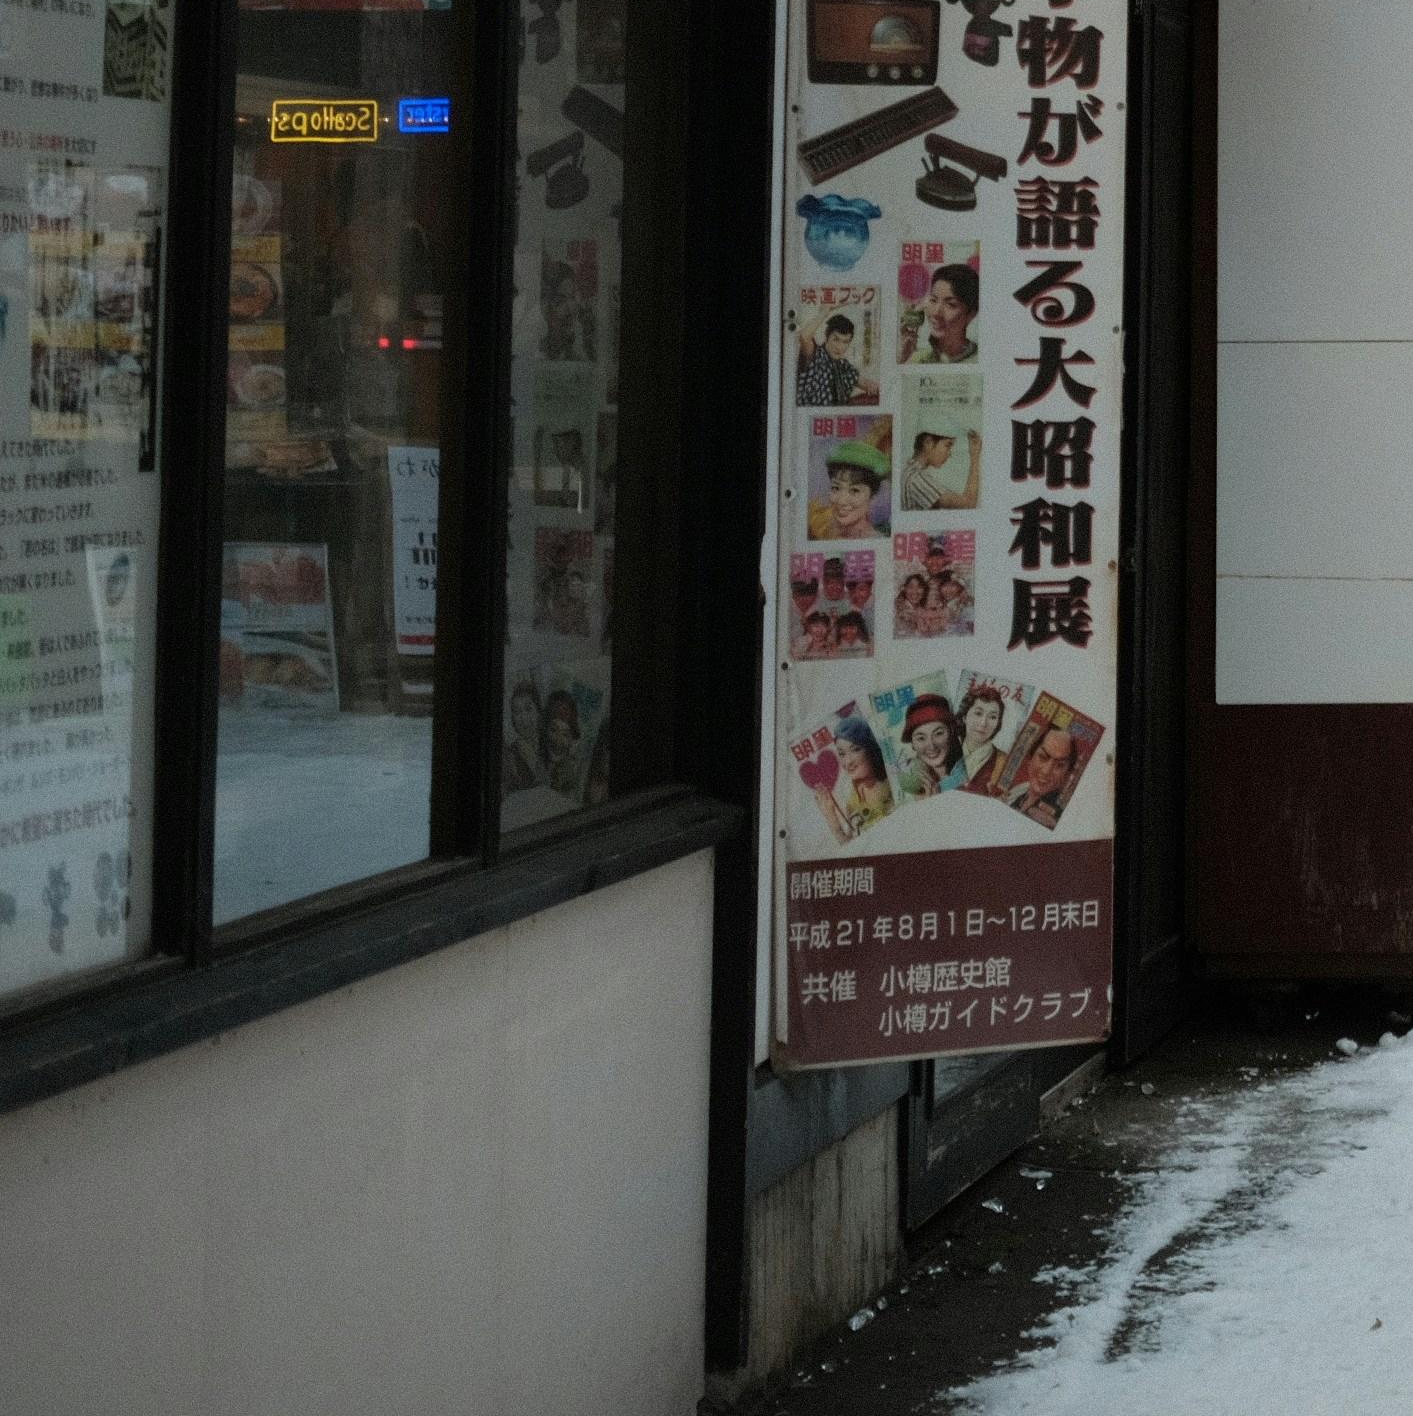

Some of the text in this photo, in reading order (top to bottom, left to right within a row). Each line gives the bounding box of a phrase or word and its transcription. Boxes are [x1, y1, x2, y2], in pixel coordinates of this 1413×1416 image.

[790, 866, 875, 901] 開催期間
[802, 957, 1011, 1005] 共催 小樽歴史館
[878, 988, 1092, 1037] 小樽ガイドクラブ
